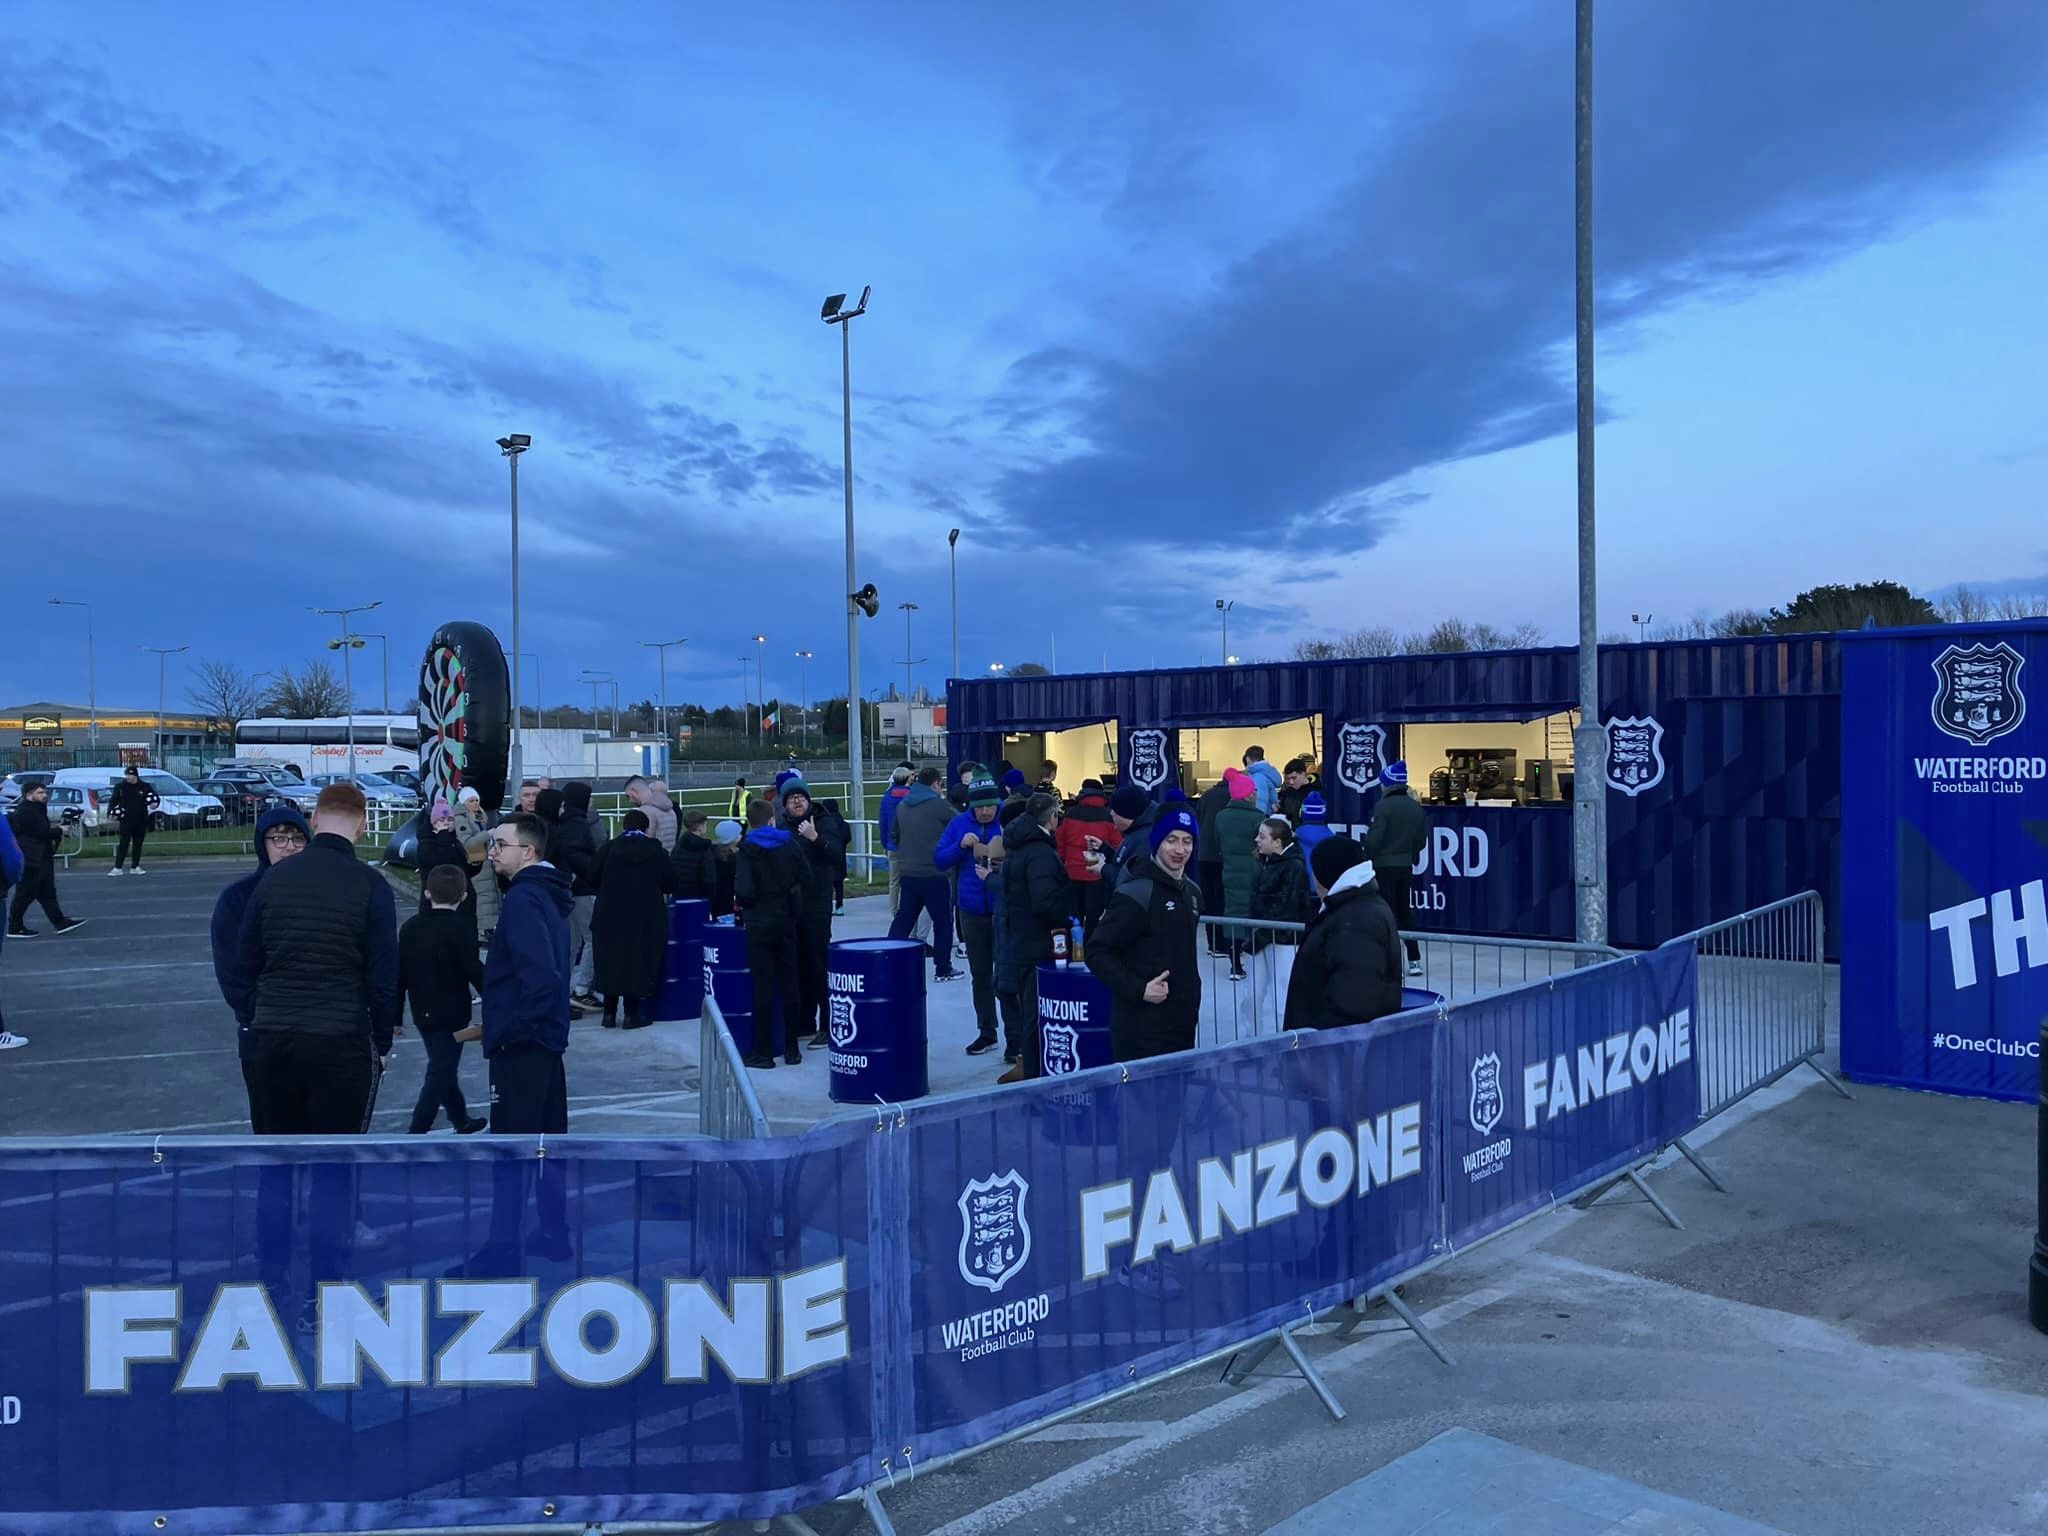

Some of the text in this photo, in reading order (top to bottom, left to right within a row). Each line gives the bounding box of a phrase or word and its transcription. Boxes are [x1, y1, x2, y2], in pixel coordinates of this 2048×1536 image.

[354, 746, 385, 757] Travel
[1914, 757, 2047, 779] WATERFORD
[1932, 780, 2024, 793] Football Club
[1409, 883, 1446, 910] lub
[1524, 1007, 1690, 1131] FANZONE
[1463, 1138, 1511, 1174] WATERFORD
[1080, 1101, 1422, 1281] FANZONE
[84, 1256, 850, 1394] FANZONE
[941, 1293, 1049, 1350] WATERFORD
[961, 1327, 1035, 1362] Football Club
